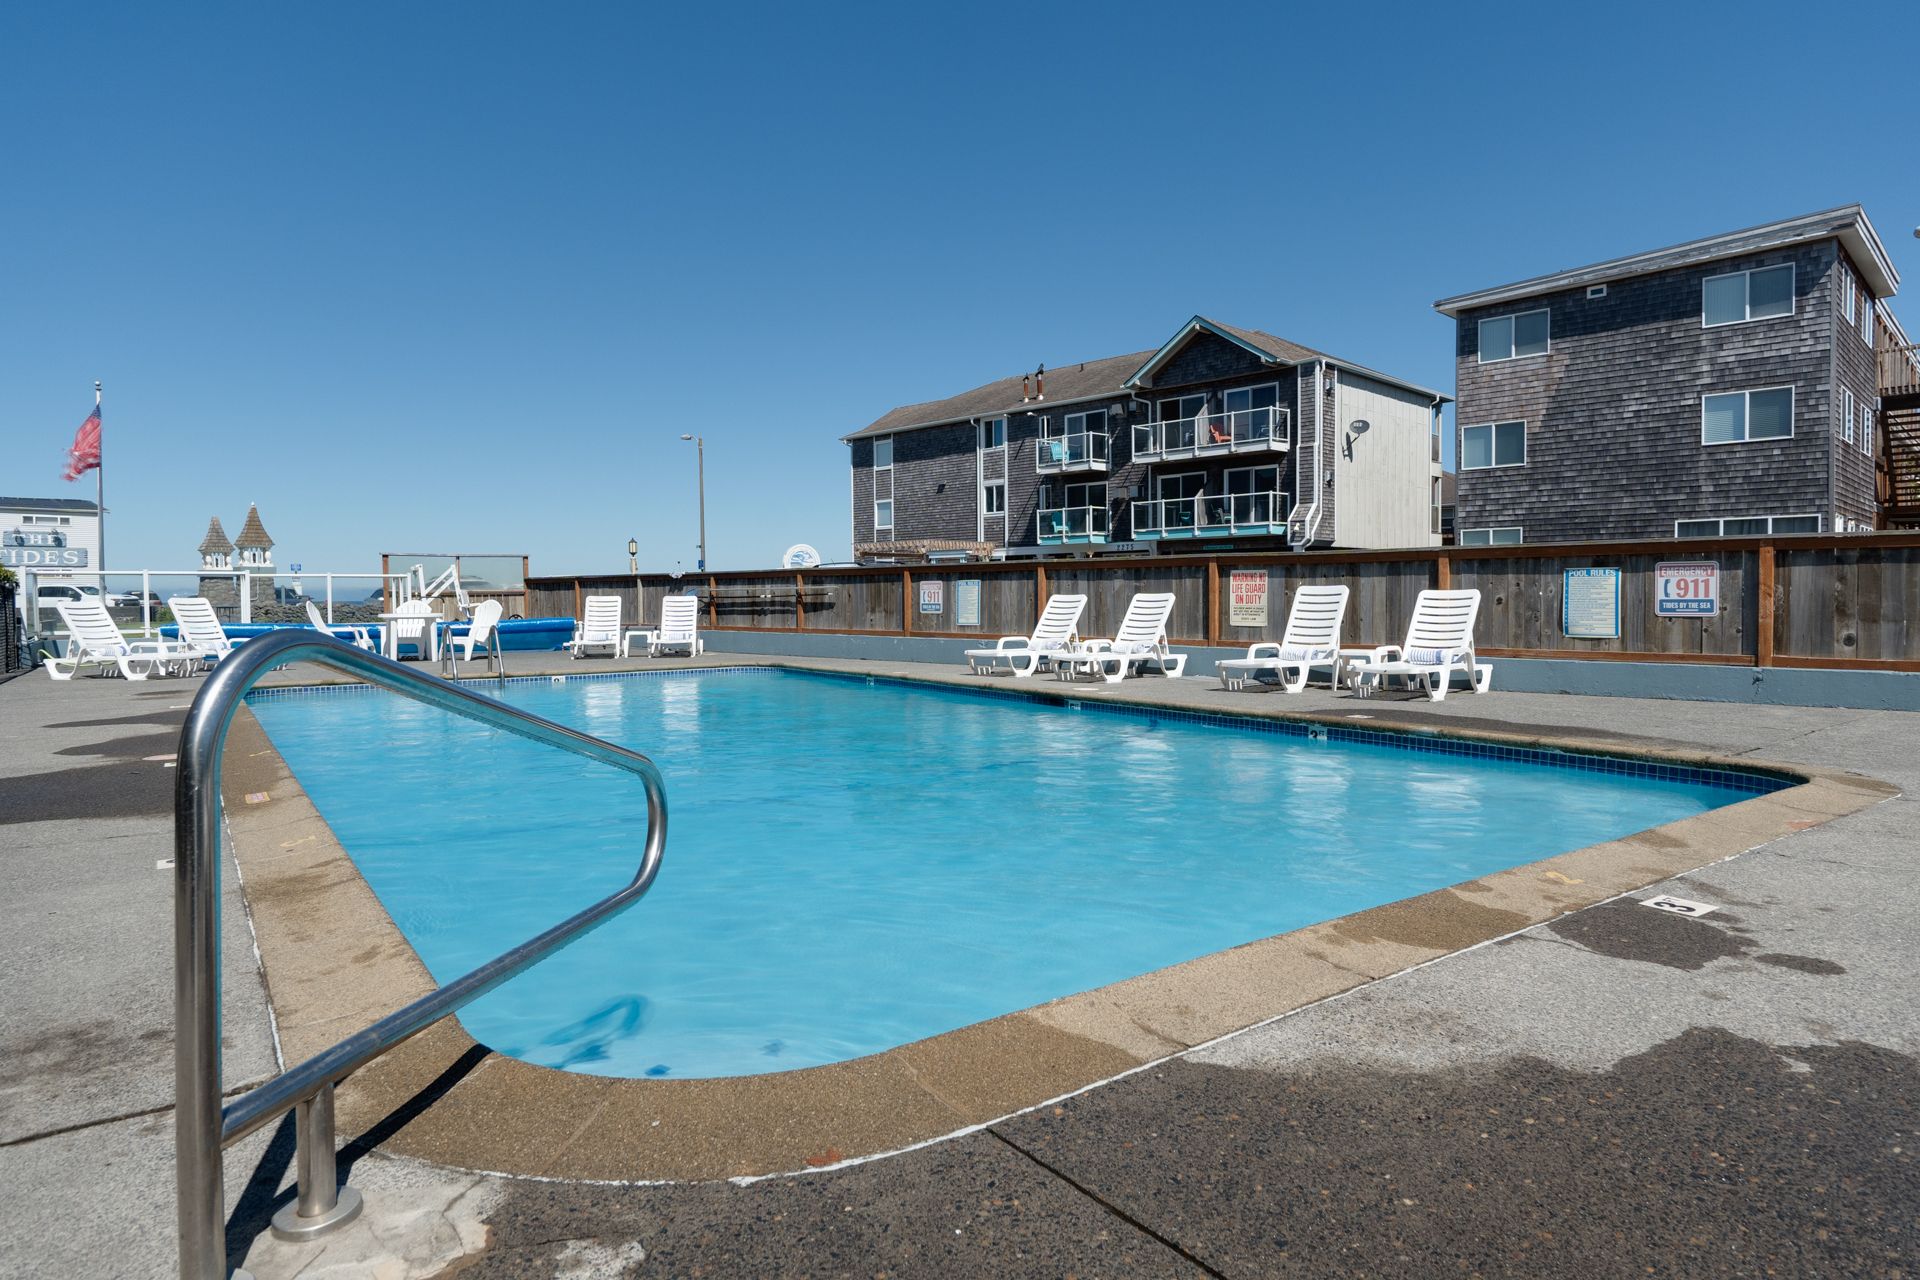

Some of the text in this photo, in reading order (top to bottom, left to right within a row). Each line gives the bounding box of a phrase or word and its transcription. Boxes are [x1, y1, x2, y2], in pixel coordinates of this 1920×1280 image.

[1569, 568, 1616, 577] POOL RULES
[1661, 566, 1713, 576] EMERGENCY
[1232, 572, 1258, 582] WARNING
[1232, 584, 1266, 593] LIFE GUARD
[1676, 578, 1710, 598] 911
[927, 591, 940, 603] 911
[1235, 594, 1262, 604] ON DUTY
